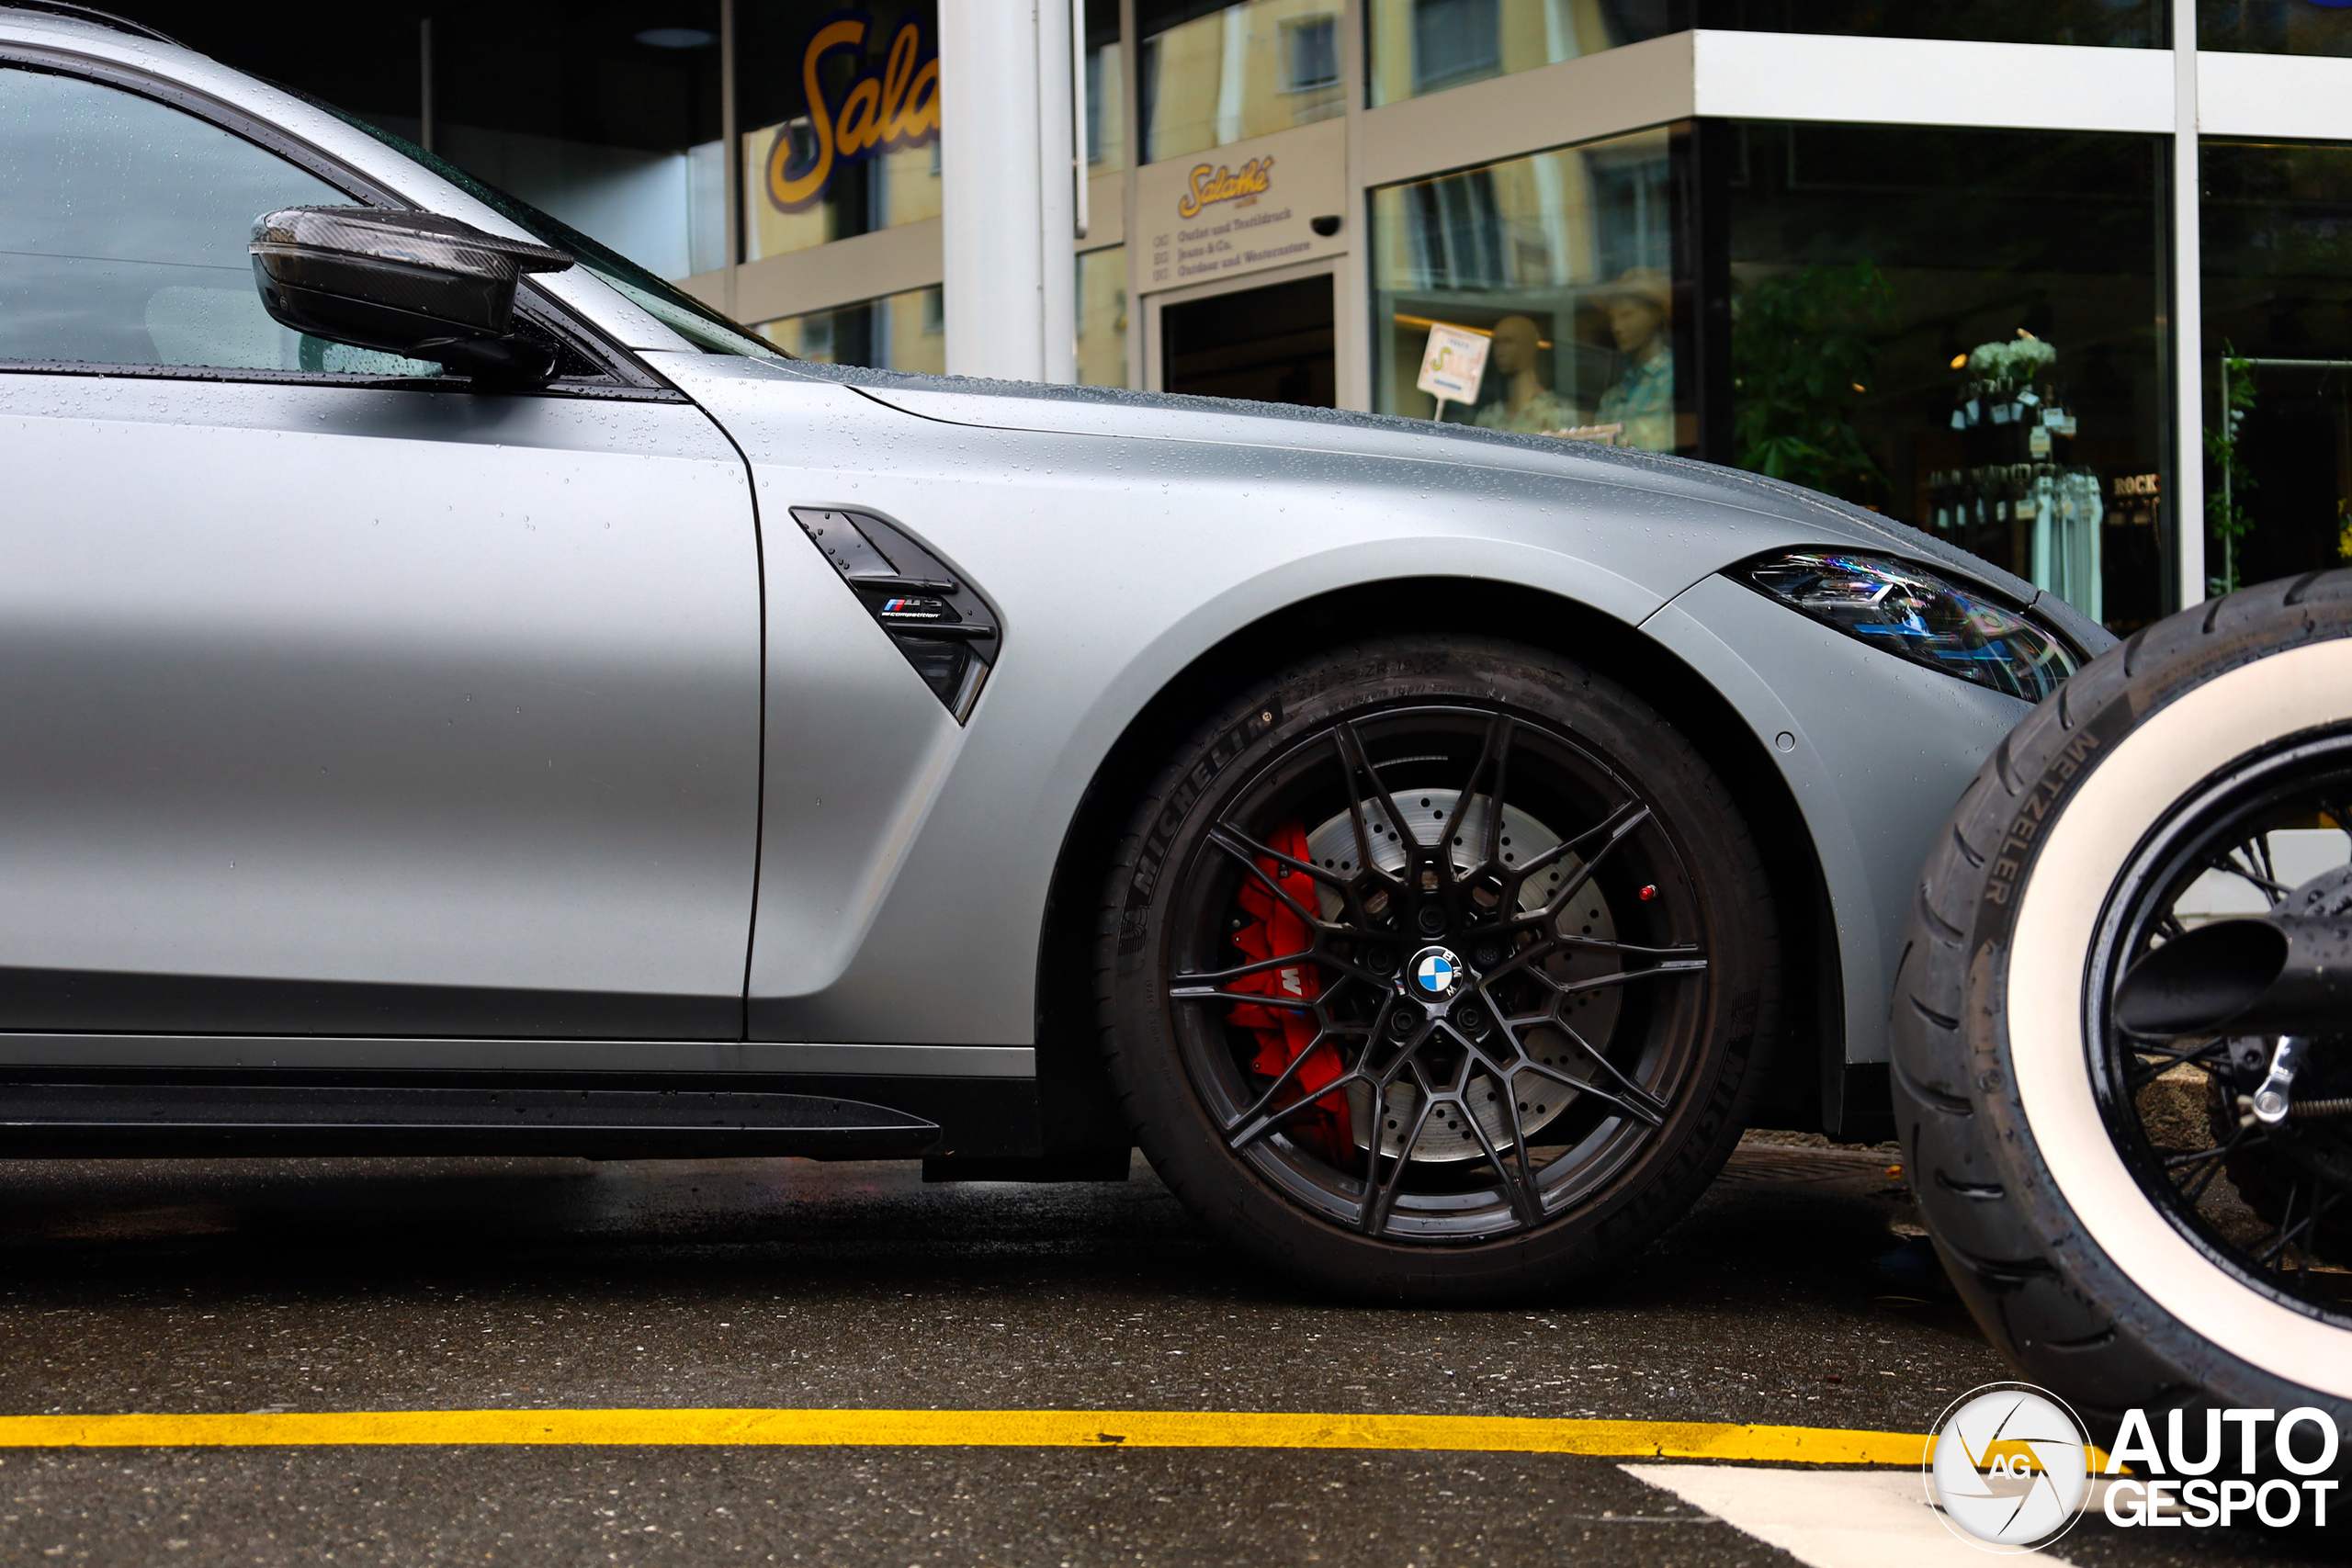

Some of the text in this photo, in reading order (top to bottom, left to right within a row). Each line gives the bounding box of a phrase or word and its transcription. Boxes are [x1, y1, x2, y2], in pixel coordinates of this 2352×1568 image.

[1179, 155, 1272, 219] Salathé
[2114, 474, 2159, 495] ROCK
[888, 611, 941, 619] competition
[1396, 658, 1413, 672] 19
[1133, 701, 1272, 897] MICHELIN
[1985, 731, 2100, 906] METZELER
[1442, 949, 1463, 997] BMW
